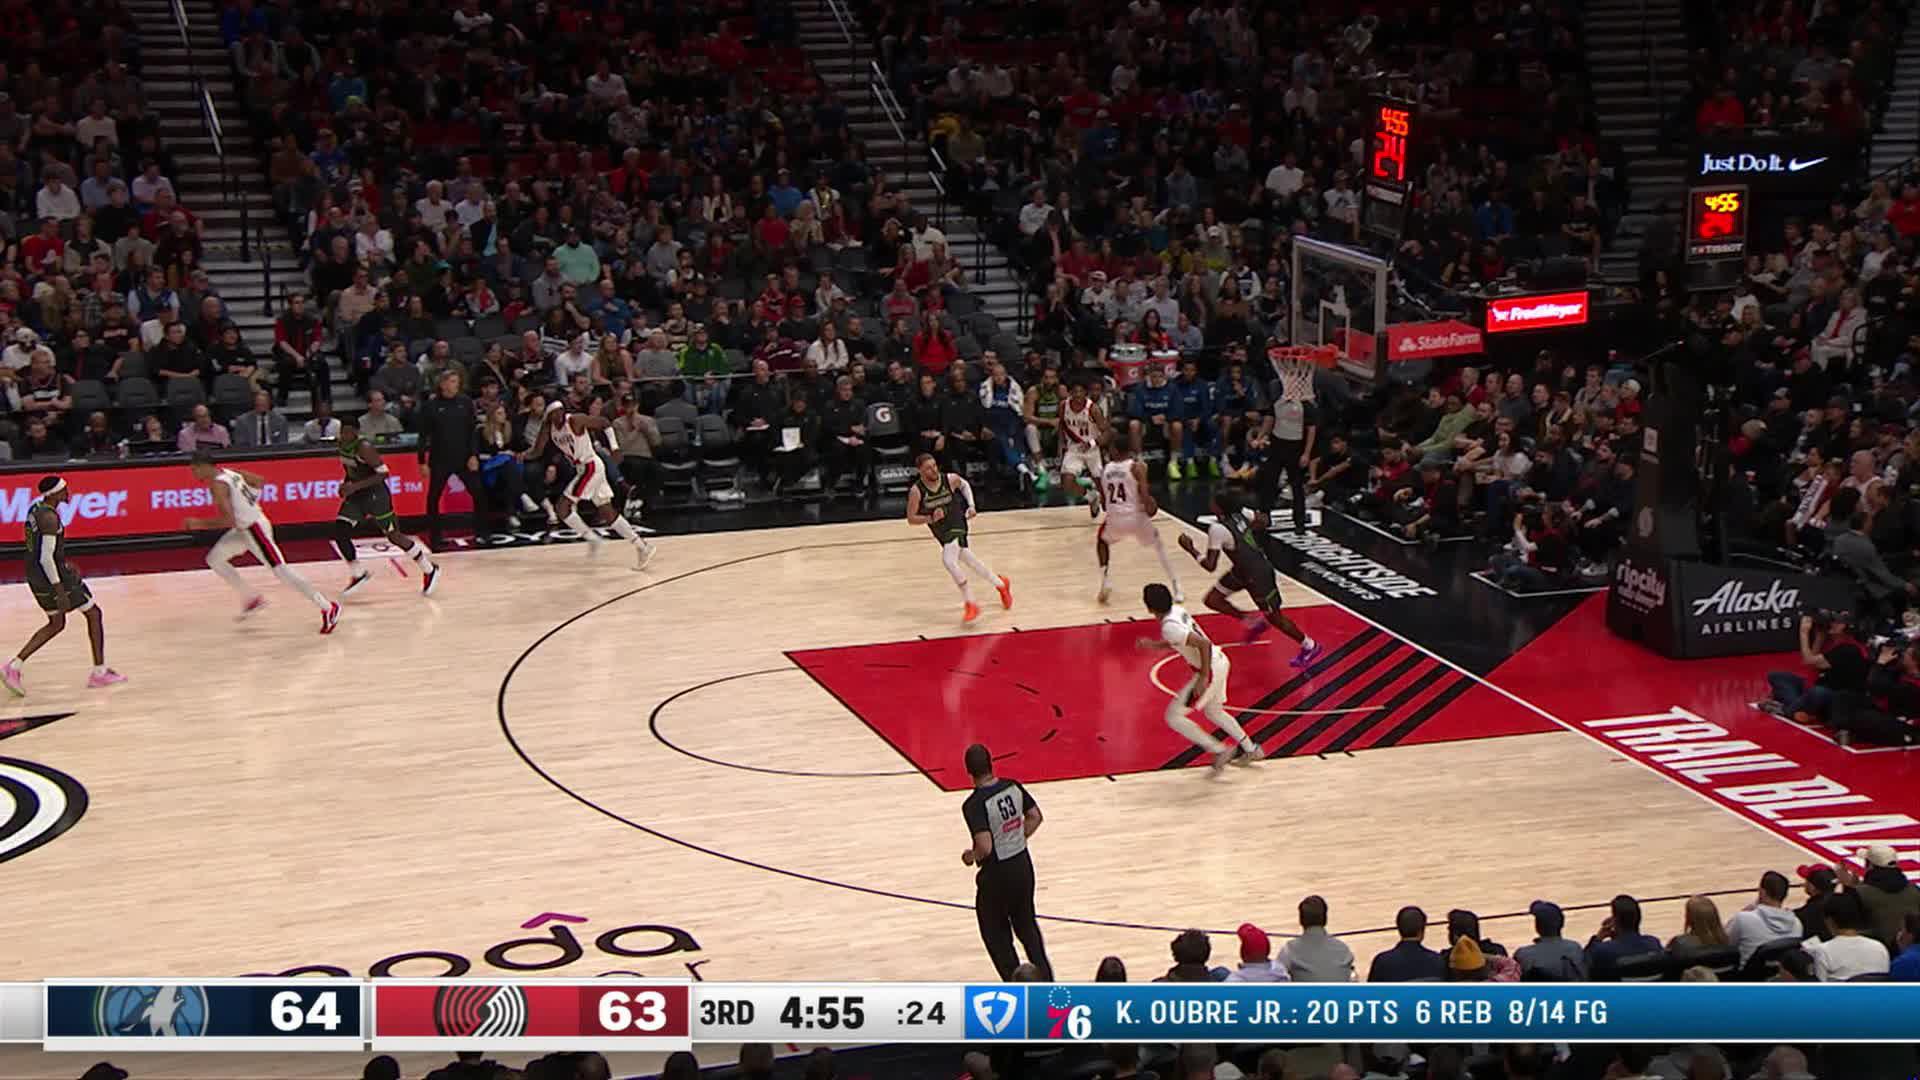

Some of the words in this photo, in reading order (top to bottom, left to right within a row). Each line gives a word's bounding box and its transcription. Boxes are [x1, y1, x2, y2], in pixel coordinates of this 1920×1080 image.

[1374, 131, 1406, 181] 24
[1701, 153, 1736, 175] Just
[1738, 153, 1768, 172] Do
[875, 406, 893, 423] G
[0, 486, 127, 528] Myer
[284, 475, 401, 501] EVERE
[1107, 482, 1127, 505] 24
[1692, 579, 1800, 616] Alaska
[1701, 616, 1793, 635] AIRLINES
[1582, 705, 1800, 784] TRAIL
[997, 795, 1017, 820] 53
